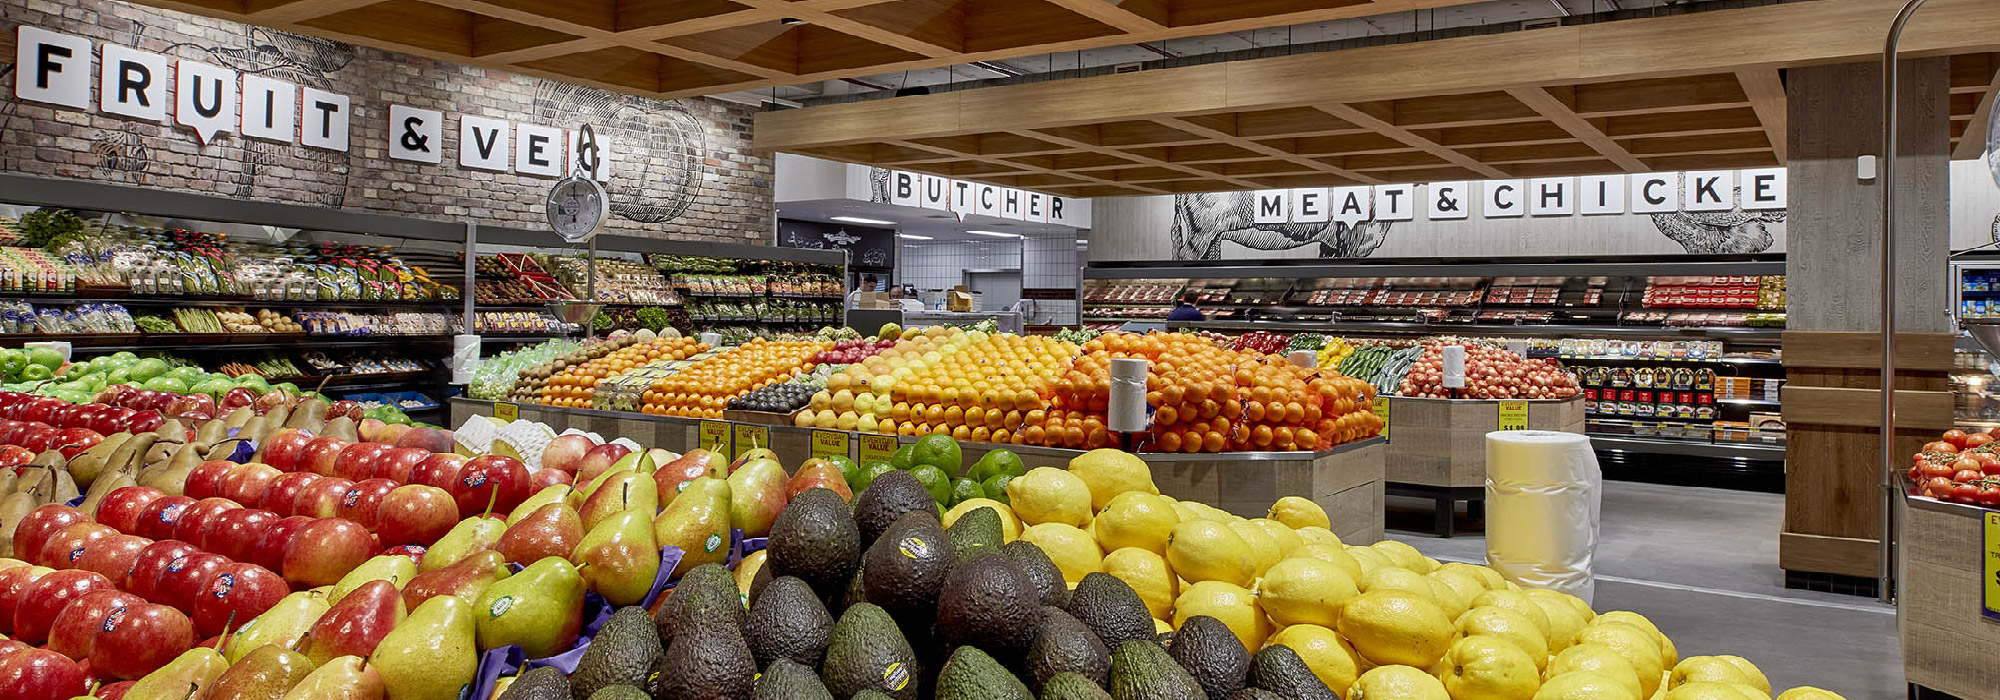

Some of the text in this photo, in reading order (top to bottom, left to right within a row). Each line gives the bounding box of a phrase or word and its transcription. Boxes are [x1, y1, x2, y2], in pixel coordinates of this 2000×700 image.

[37, 43, 338, 138] FRUIT
[401, 116, 430, 152] &
[898, 173, 1063, 219] BUTCHER
[1261, 174, 1776, 217] MEAT & CHICKE
[706, 428, 725, 436] VALUE
[815, 431, 845, 440] EVERYDAY
[863, 436, 894, 445] EVERYDAY
[869, 443, 890, 451] VALUE
